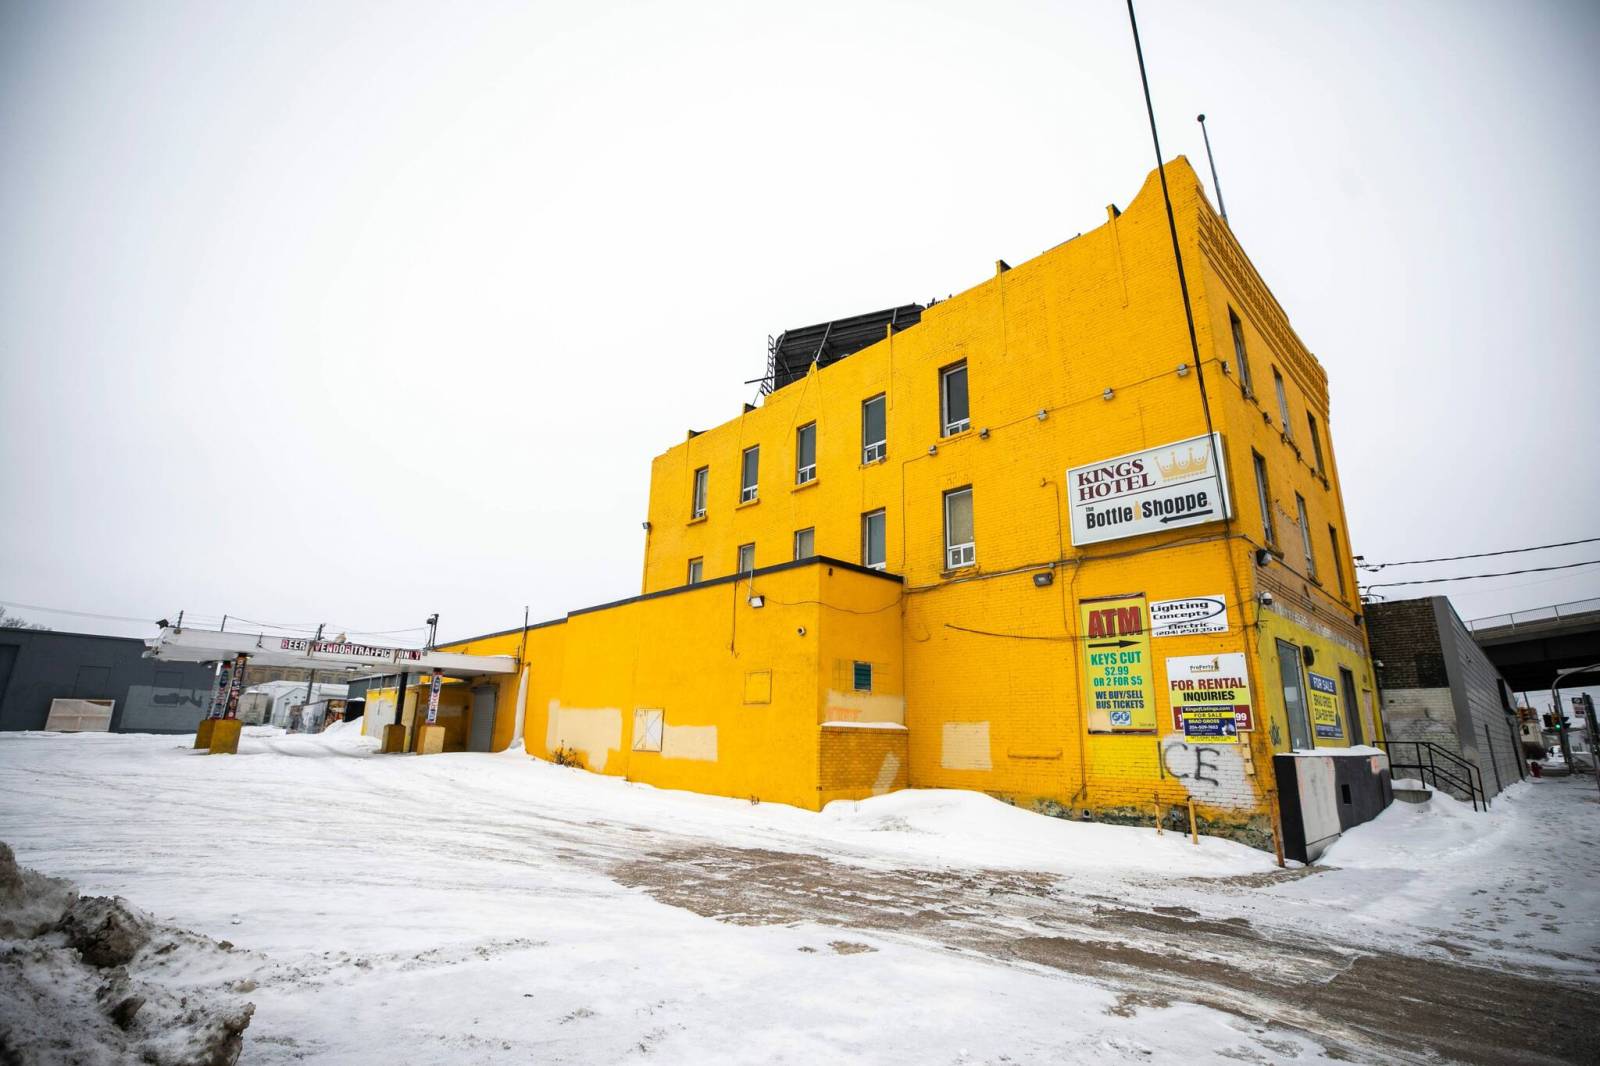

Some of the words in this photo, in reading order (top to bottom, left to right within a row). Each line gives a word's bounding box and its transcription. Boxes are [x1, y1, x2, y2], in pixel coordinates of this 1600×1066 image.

[1078, 459, 1144, 487] KINGS
[1079, 473, 1156, 501] HOTEL
[1086, 506, 1133, 529] Bottle
[1142, 491, 1207, 518] Shoppe
[1151, 602, 1208, 612] Lighting
[1153, 611, 1209, 620] Concepts
[1088, 606, 1142, 639] ATM
[1169, 622, 1208, 630] Electric
[281, 640, 306, 650] BEER
[314, 643, 352, 655] VENDOR
[353, 645, 390, 658] TRAFFIC
[399, 648, 421, 660] ONLY
[1090, 653, 1117, 666] KEYS
[1119, 651, 1141, 664] CUT
[1105, 666, 1128, 676] $2.99
[1093, 678, 1104, 687] OR
[1106, 677, 1112, 686] 2
[1113, 676, 1129, 686] FOR
[1131, 675, 1143, 685] $5
[1171, 680, 1194, 691] FOR
[1198, 677, 1246, 689] RENTAL
[1313, 677, 1322, 688] FOR
[1323, 680, 1334, 692] SALE
[1095, 691, 1107, 700] WE
[1109, 690, 1143, 699] BUY/SELL
[1183, 691, 1235, 701] INQUIRIES
[1096, 700, 1111, 709] BUS
[1113, 699, 1144, 709] TICKETS
